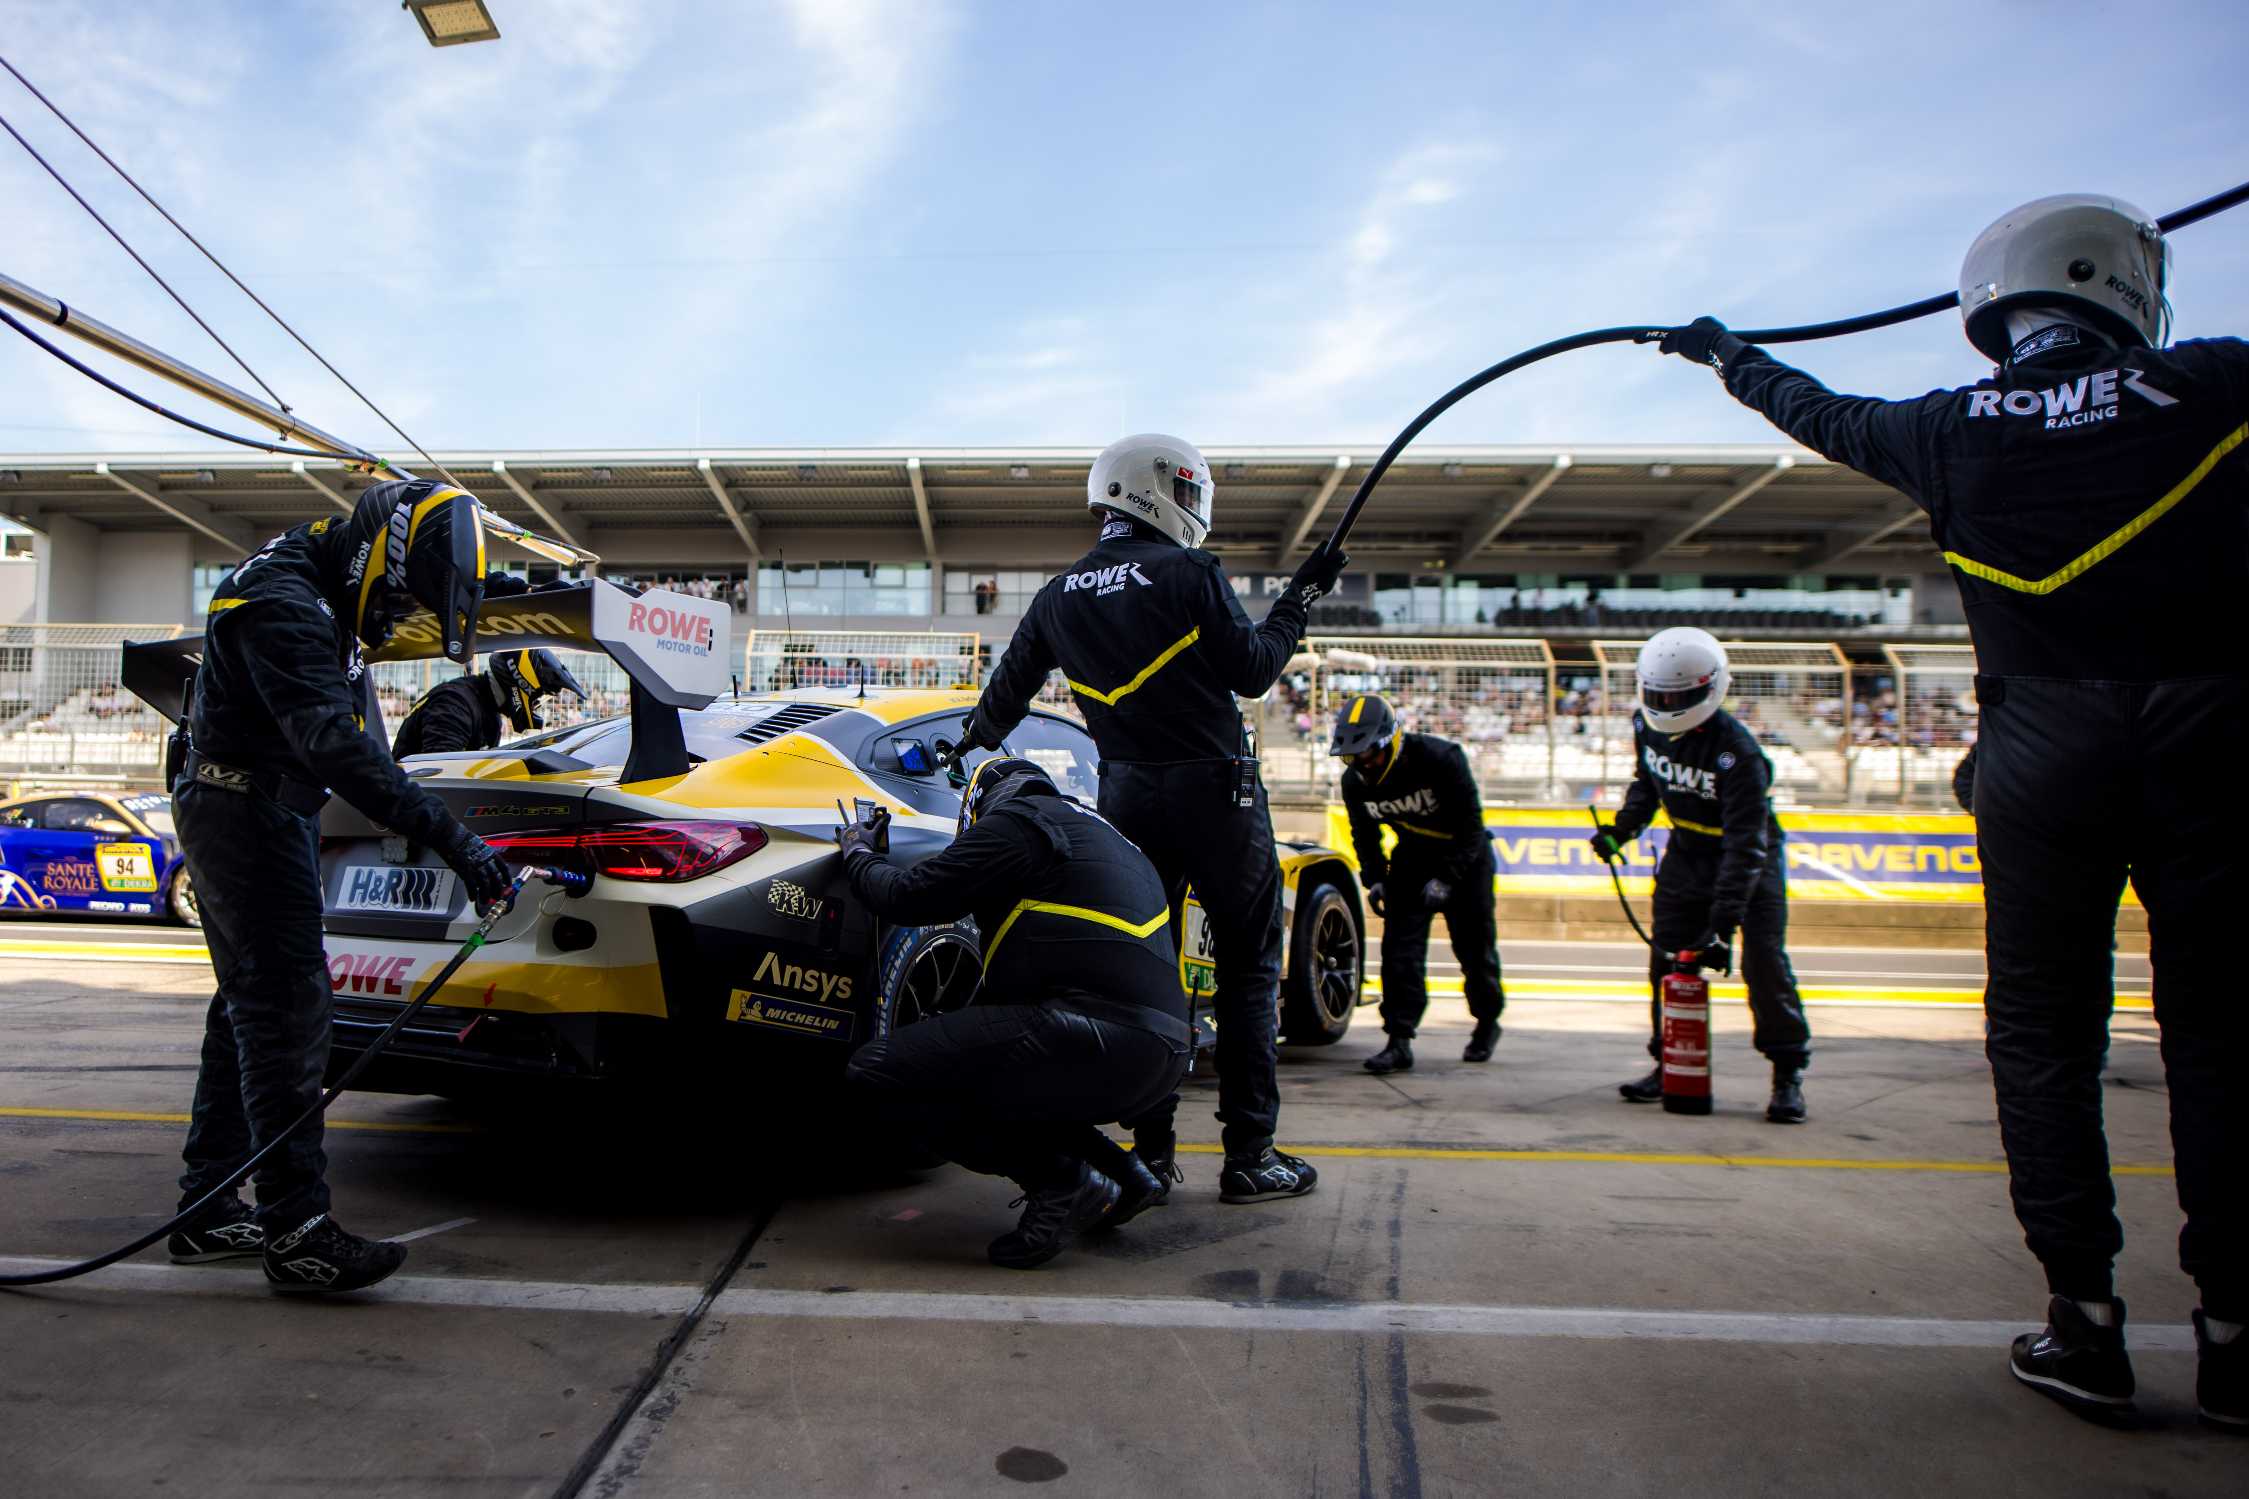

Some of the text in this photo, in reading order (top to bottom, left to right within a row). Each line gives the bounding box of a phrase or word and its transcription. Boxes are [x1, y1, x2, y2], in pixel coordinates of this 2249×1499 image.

[2104, 273, 2145, 305] ROWE
[1967, 369, 2119, 418] ROWE
[2045, 405, 2118, 429] RACING
[1126, 492, 1155, 512] ROWE
[386, 502, 413, 590] 100%
[353, 541, 371, 584] ROWE
[1063, 562, 1129, 592] ROWE
[1096, 582, 1125, 597] RACING
[628, 602, 711, 645] ROWE
[656, 637, 709, 657] MOTOR OIL
[506, 658, 536, 696] uvex
[1645, 745, 1716, 792] ROWE
[1364, 788, 1436, 819] ROWE
[47, 862, 96, 877] SANTE
[116, 857, 134, 875] 94
[1786, 842, 1981, 873] RAVENO
[43, 876, 99, 892] ROYALE
[348, 867, 402, 908] H&R
[326, 953, 416, 995] OWE
[753, 951, 853, 1001] Ansys
[766, 1006, 840, 1031] MICHELIN
